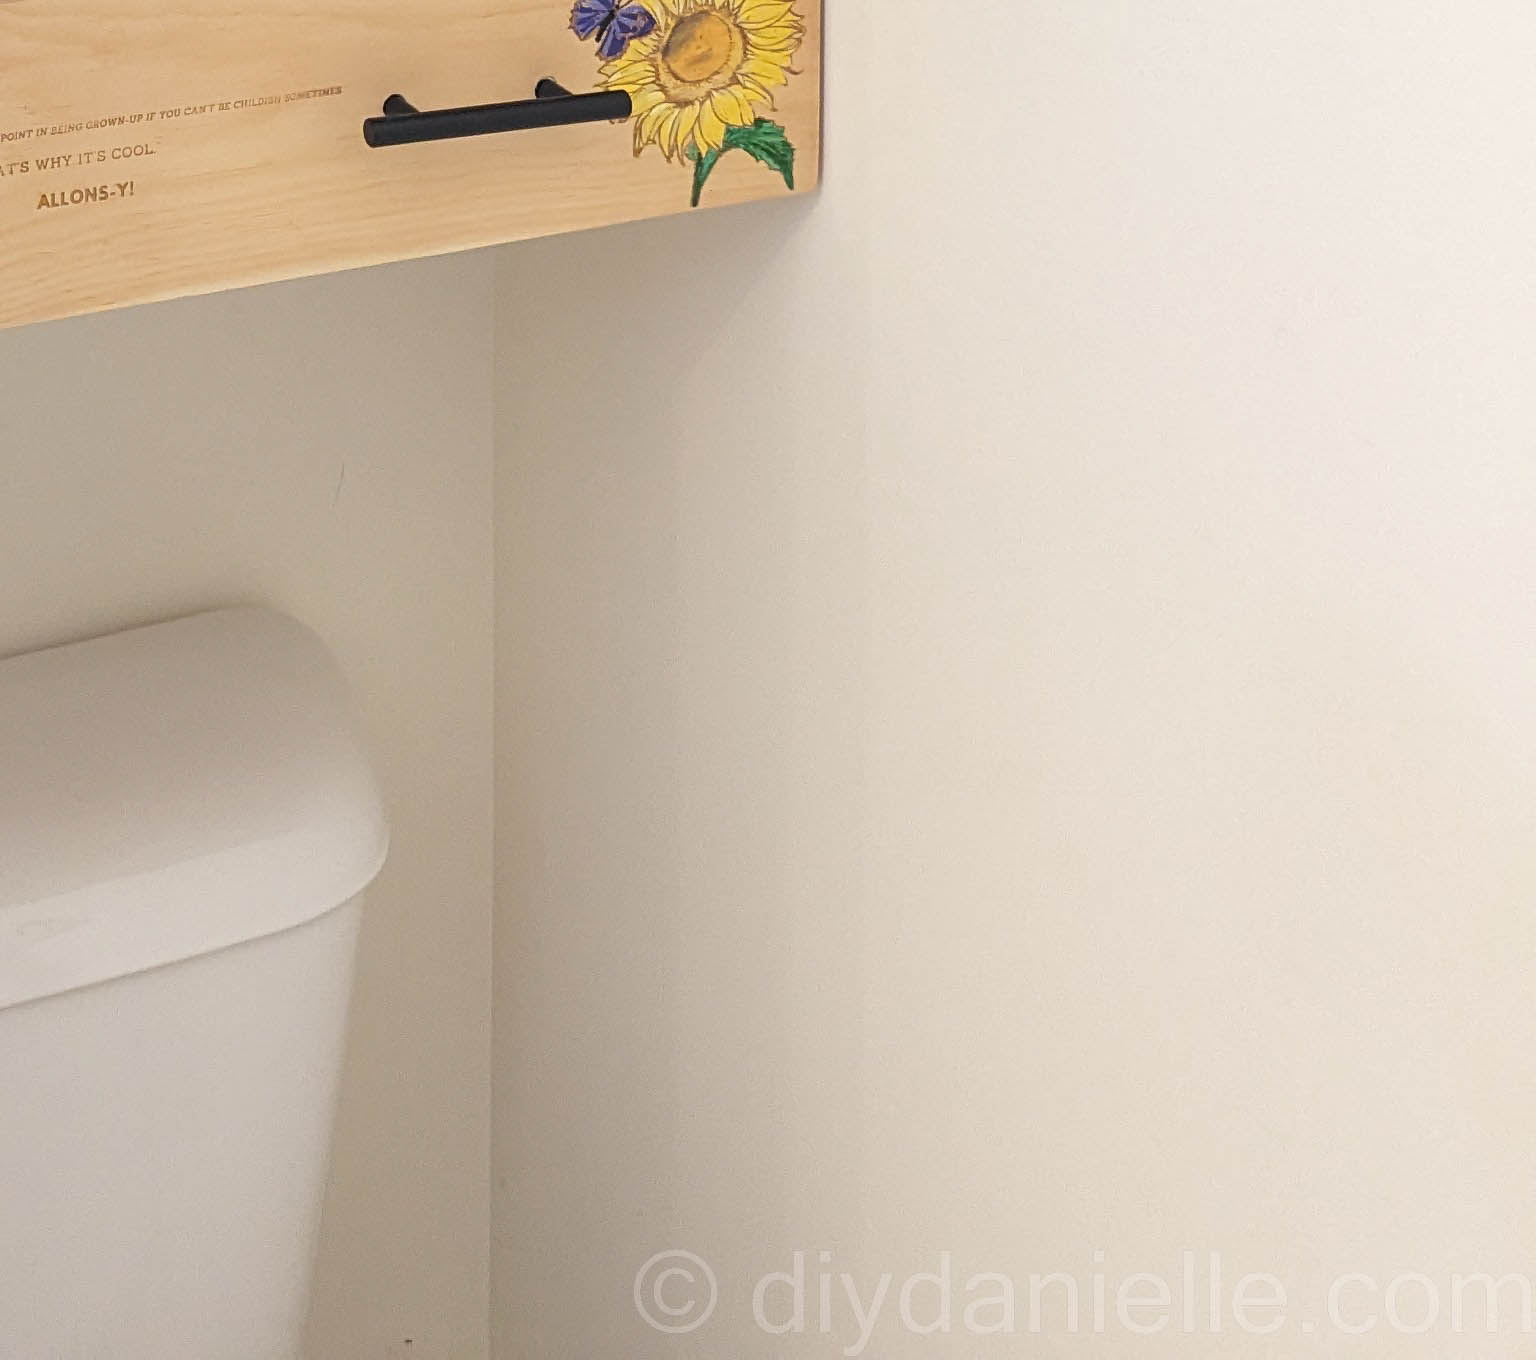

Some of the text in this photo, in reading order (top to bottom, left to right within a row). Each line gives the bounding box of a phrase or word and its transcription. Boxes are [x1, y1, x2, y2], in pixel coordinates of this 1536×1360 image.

[0, 129, 33, 143] POINT
[35, 127, 48, 137] IN
[50, 122, 83, 136] BEING
[85, 114, 144, 130] GROWN-UP
[146, 112, 157, 122] IF
[160, 108, 181, 120] YOU
[218, 101, 231, 111] BE
[35, 154, 73, 171] WHY
[36, 180, 135, 210] ALLONS-Y!
